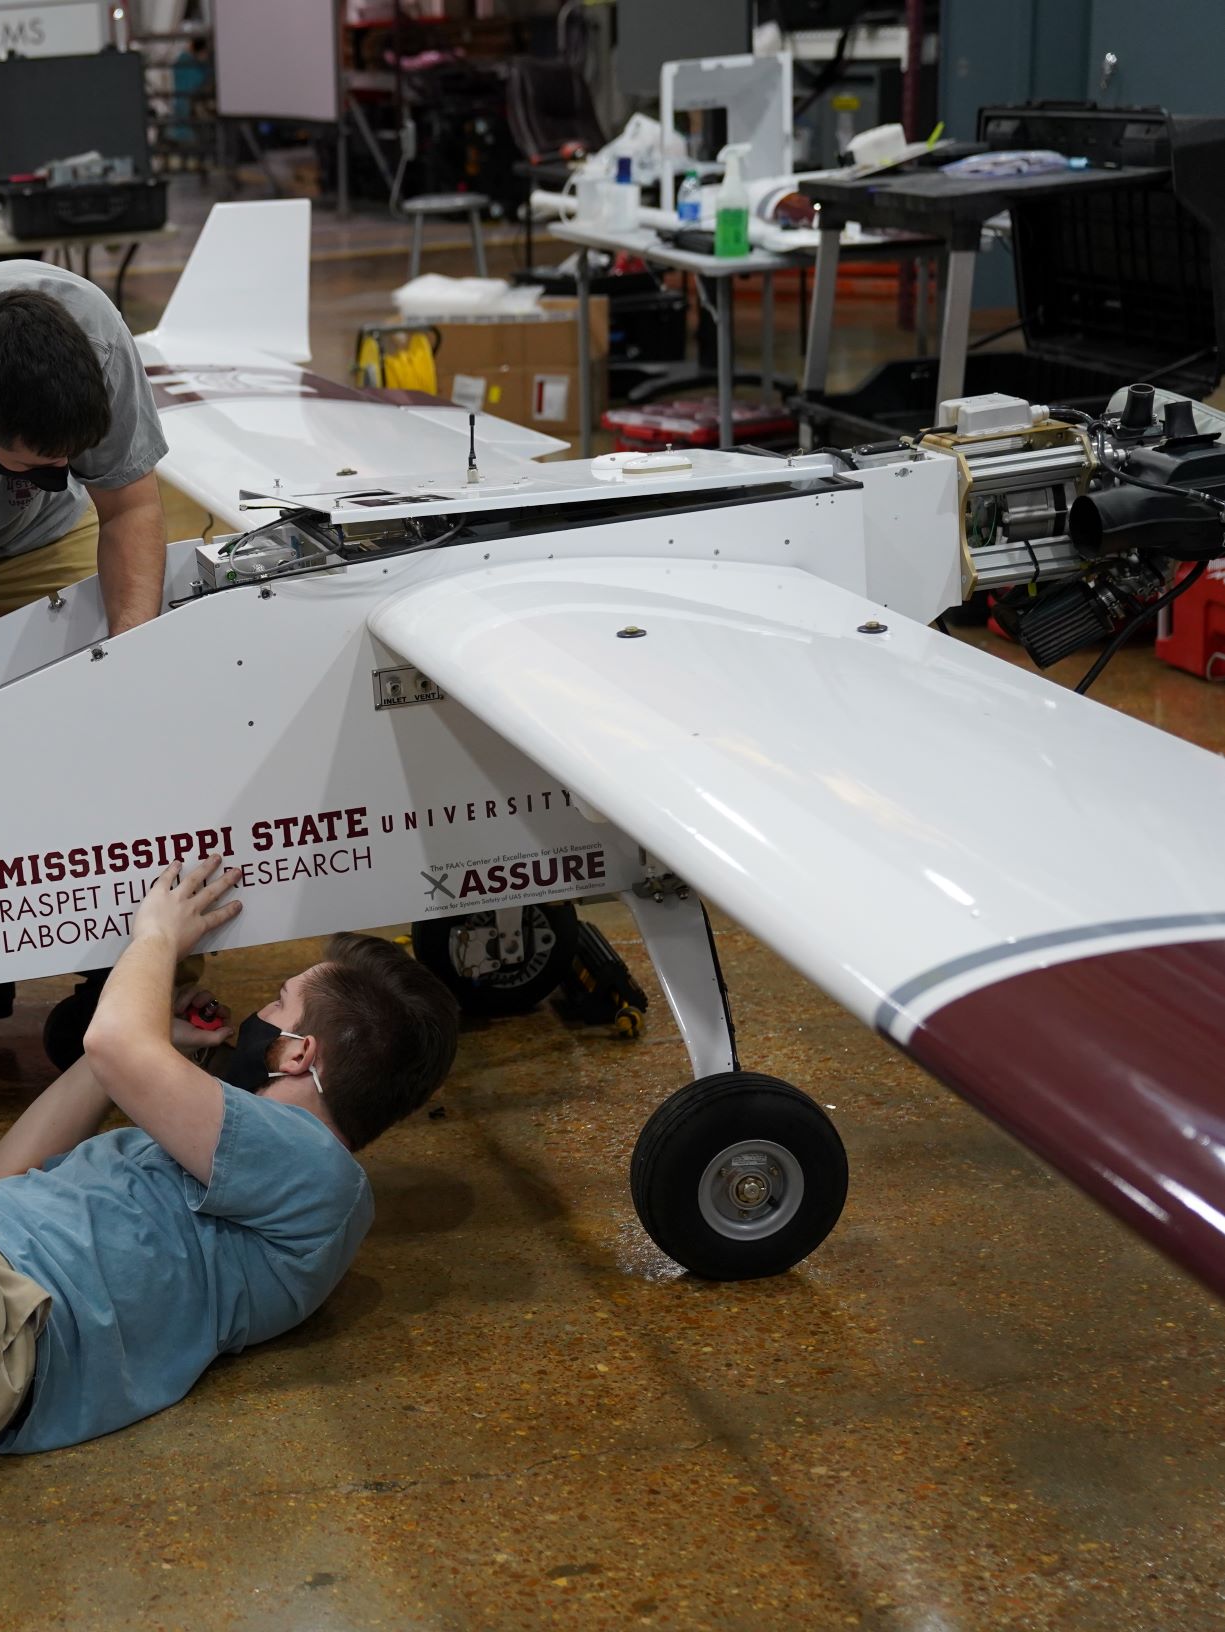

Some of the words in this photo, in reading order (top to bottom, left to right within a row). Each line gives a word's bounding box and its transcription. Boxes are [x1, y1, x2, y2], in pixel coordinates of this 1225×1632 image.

[383, 696, 407, 705] INLET
[414, 692, 437, 701] VENT
[252, 807, 369, 851] STATE
[381, 789, 571, 833] UNIVERSITY
[430, 864, 444, 872] The
[446, 861, 465, 870] FAA's
[466, 858, 491, 867] Center
[492, 855, 500, 863] of
[502, 851, 539, 862] Excellence
[541, 848, 550, 856] for
[552, 846, 568, 854] UAS
[570, 842, 602, 852] Research
[459, 850, 606, 898] ASSURE
[460, 900, 481, 909] System
[481, 897, 500, 906] Safety
[509, 893, 521, 901] UAS
